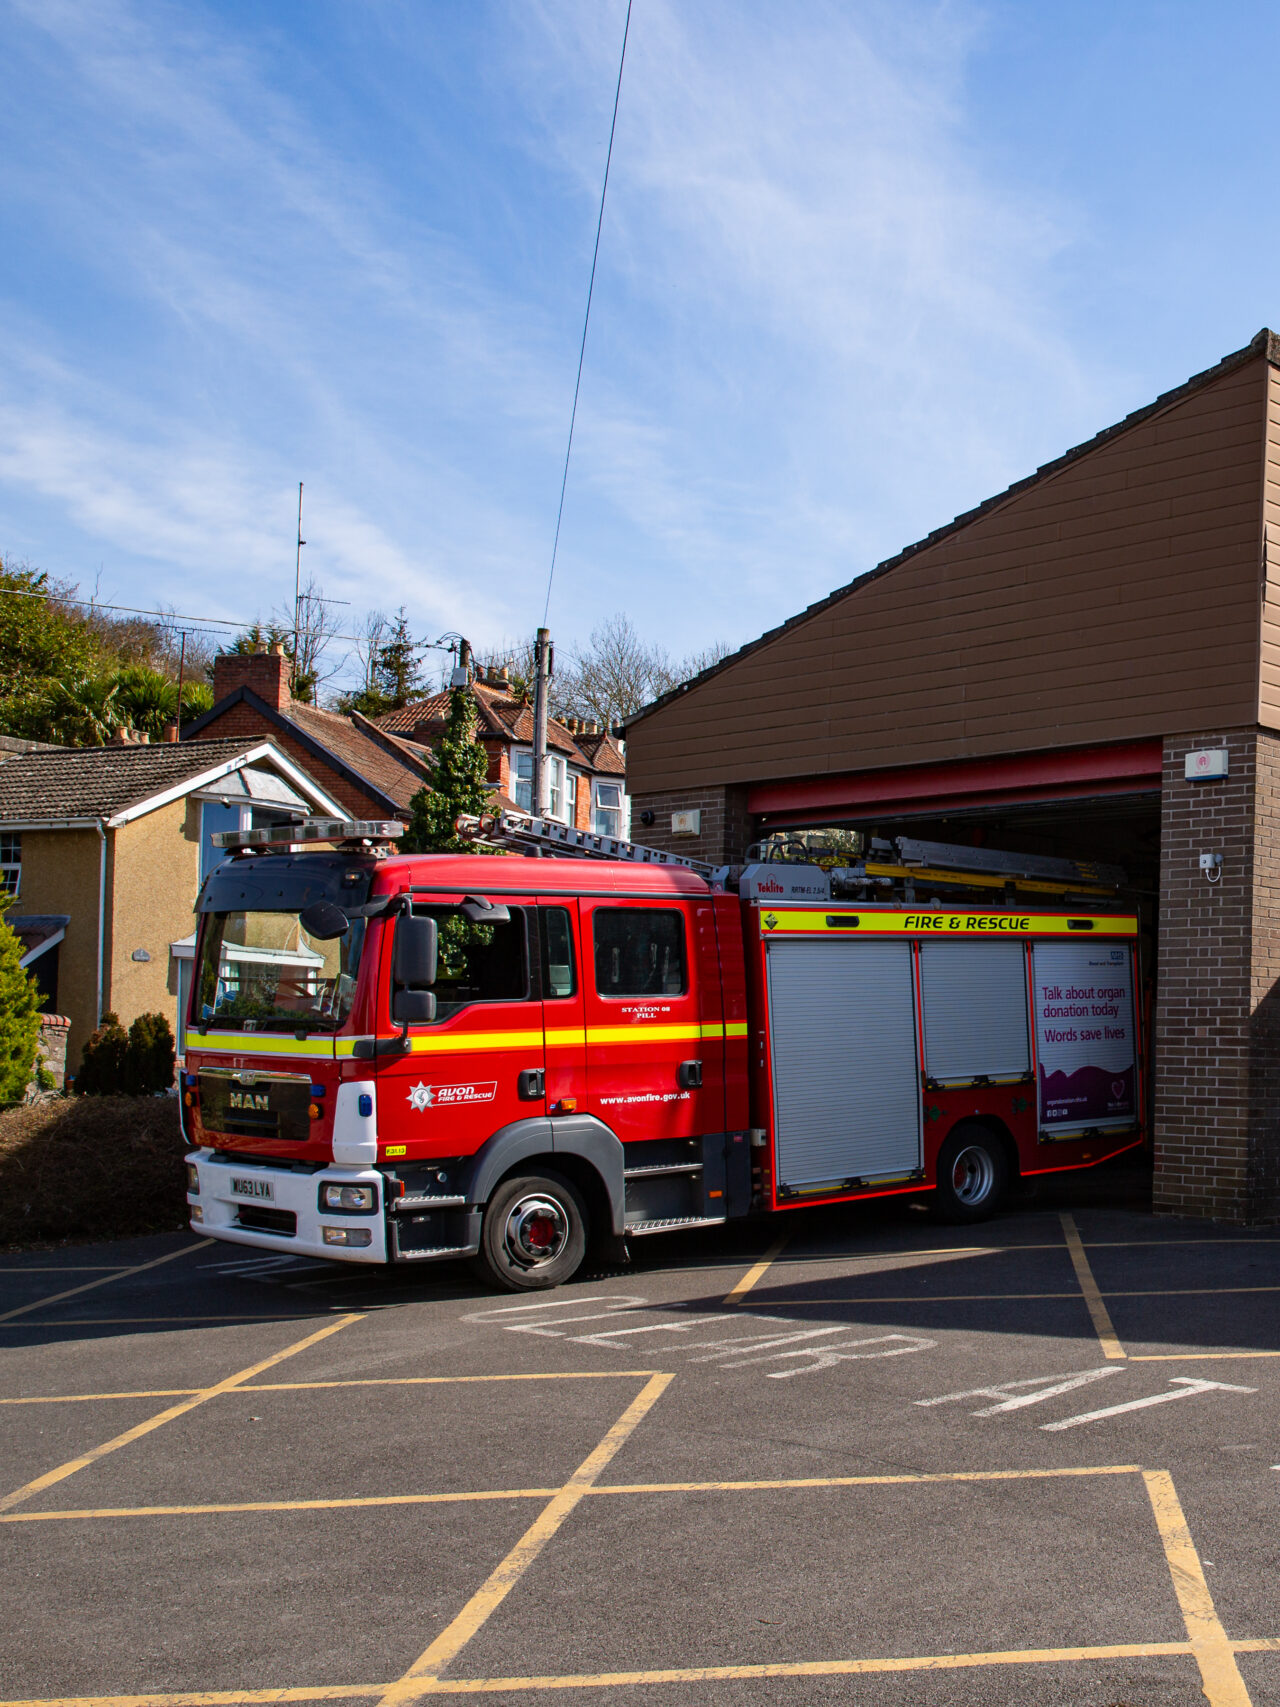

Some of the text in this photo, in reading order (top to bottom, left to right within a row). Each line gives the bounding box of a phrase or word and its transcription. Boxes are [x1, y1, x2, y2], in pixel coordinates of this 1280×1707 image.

[757, 880, 784, 893] Teklite
[904, 916, 1030, 930] FIRE & RESCUE
[1042, 986, 1126, 1002] Talk about organ
[1043, 1002, 1119, 1019] donation today
[1044, 1026, 1126, 1043] Words save lives
[438, 1086, 475, 1097] AVON
[463, 1092, 493, 1100] RESCUE
[600, 1091, 691, 1105] www.avonfire.gov.uk
[230, 1092, 269, 1111] MAN
[233, 1180, 271, 1198] WU63 LVA
[459, 1296, 938, 1378] CLEAR
[911, 1366, 1259, 1431] AT
